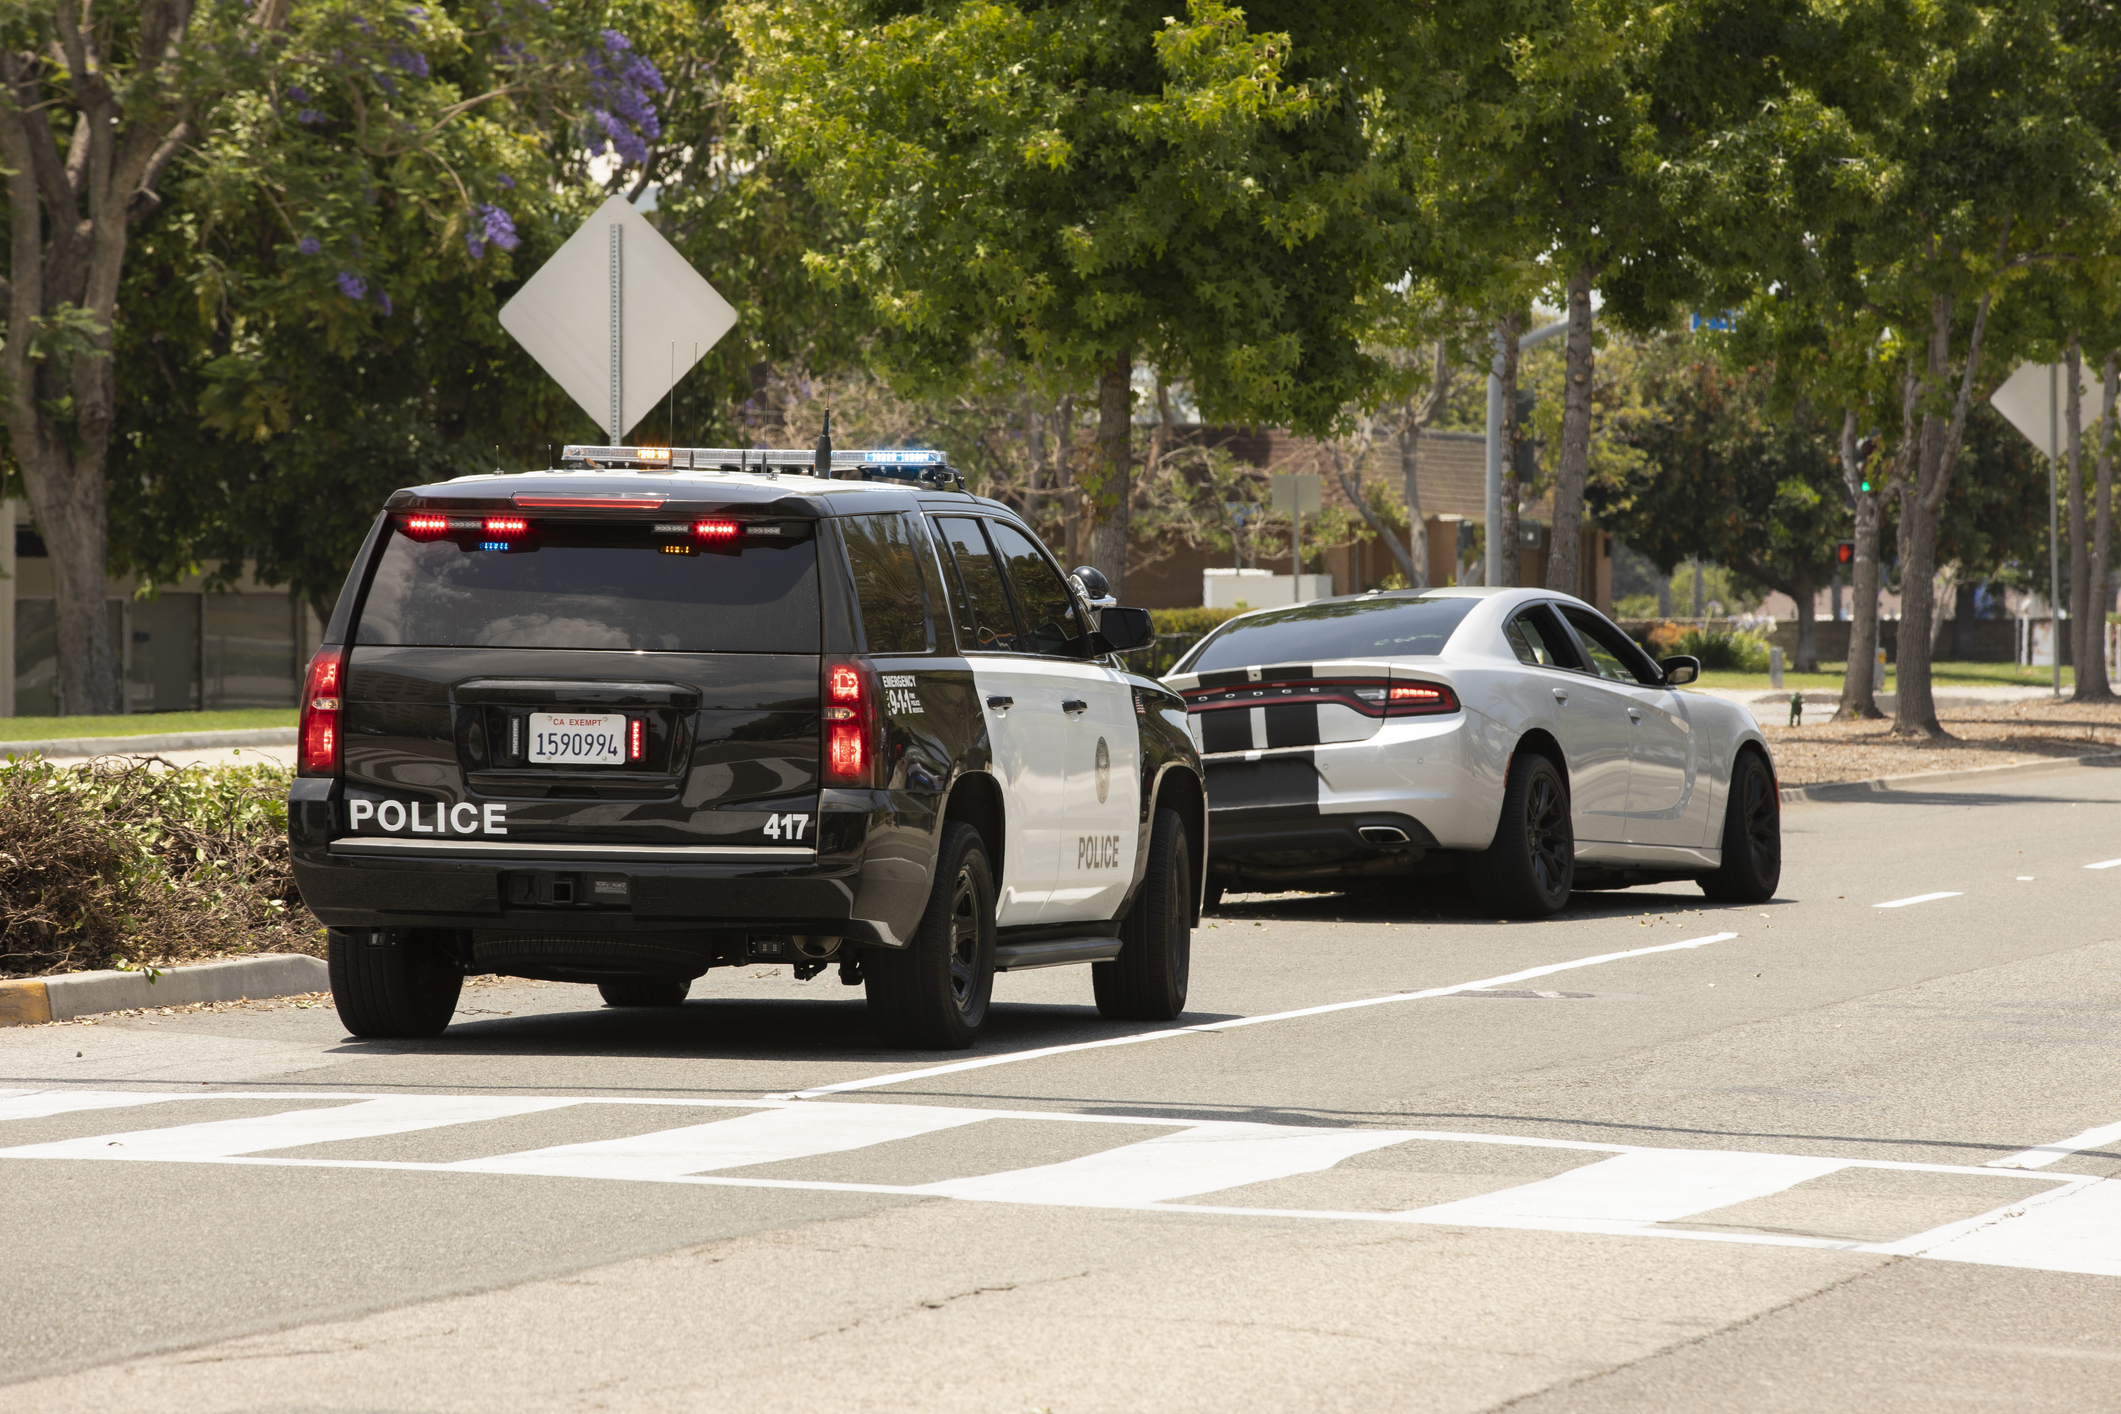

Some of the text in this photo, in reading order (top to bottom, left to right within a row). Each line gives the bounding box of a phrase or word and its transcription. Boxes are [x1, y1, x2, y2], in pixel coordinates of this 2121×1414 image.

[882, 675, 916, 687] EMERGENCY
[1198, 687, 1320, 702] DODGE
[553, 718, 602, 727] CA EXEMPT
[536, 732, 618, 757] 1590994
[350, 799, 508, 835] POLICE
[763, 813, 809, 840] 417
[1077, 835, 1120, 870] POLICE
